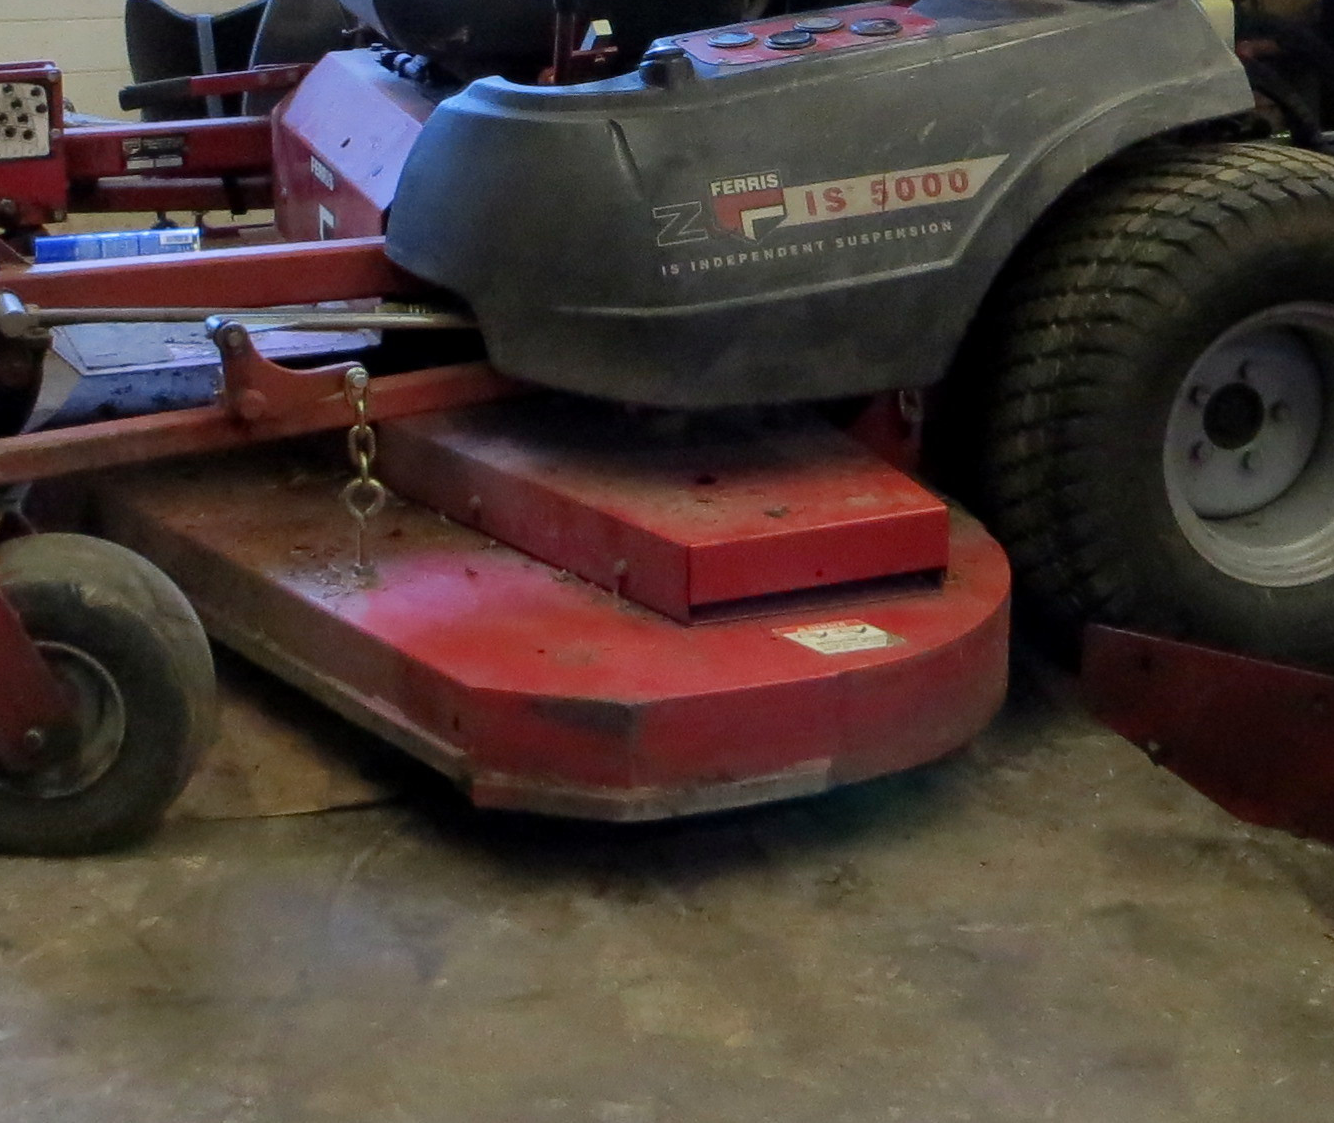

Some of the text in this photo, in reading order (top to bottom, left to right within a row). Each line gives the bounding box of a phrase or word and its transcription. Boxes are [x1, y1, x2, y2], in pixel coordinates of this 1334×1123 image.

[711, 173, 779, 197] FERRIS
[805, 168, 969, 216] IS 5000
[661, 220, 954, 277] IS INDEPENDENT SUSPENSION
